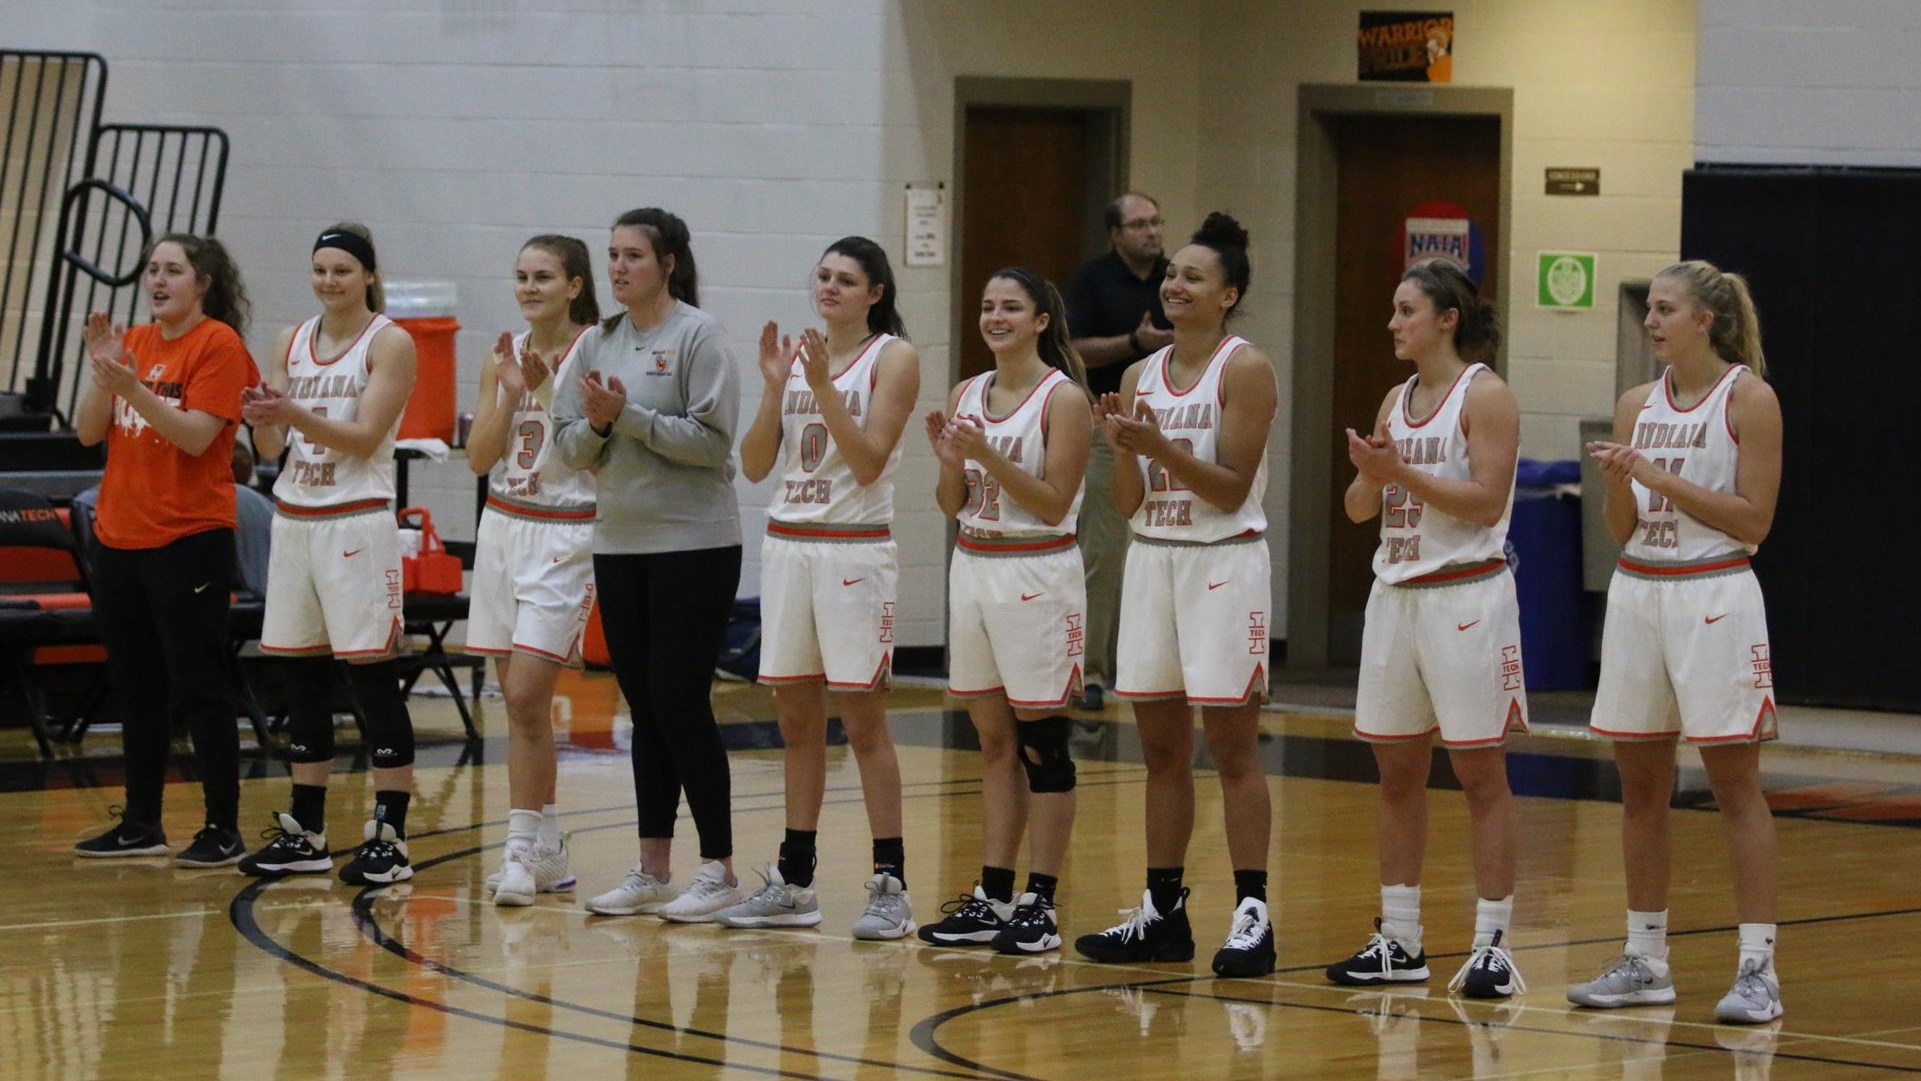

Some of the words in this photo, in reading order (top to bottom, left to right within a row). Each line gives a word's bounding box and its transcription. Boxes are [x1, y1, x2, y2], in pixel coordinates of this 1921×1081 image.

[1410, 233, 1463, 258] NAIA
[517, 420, 544, 469] 3
[801, 423, 828, 473] 0
[1144, 499, 1193, 527] TECH
